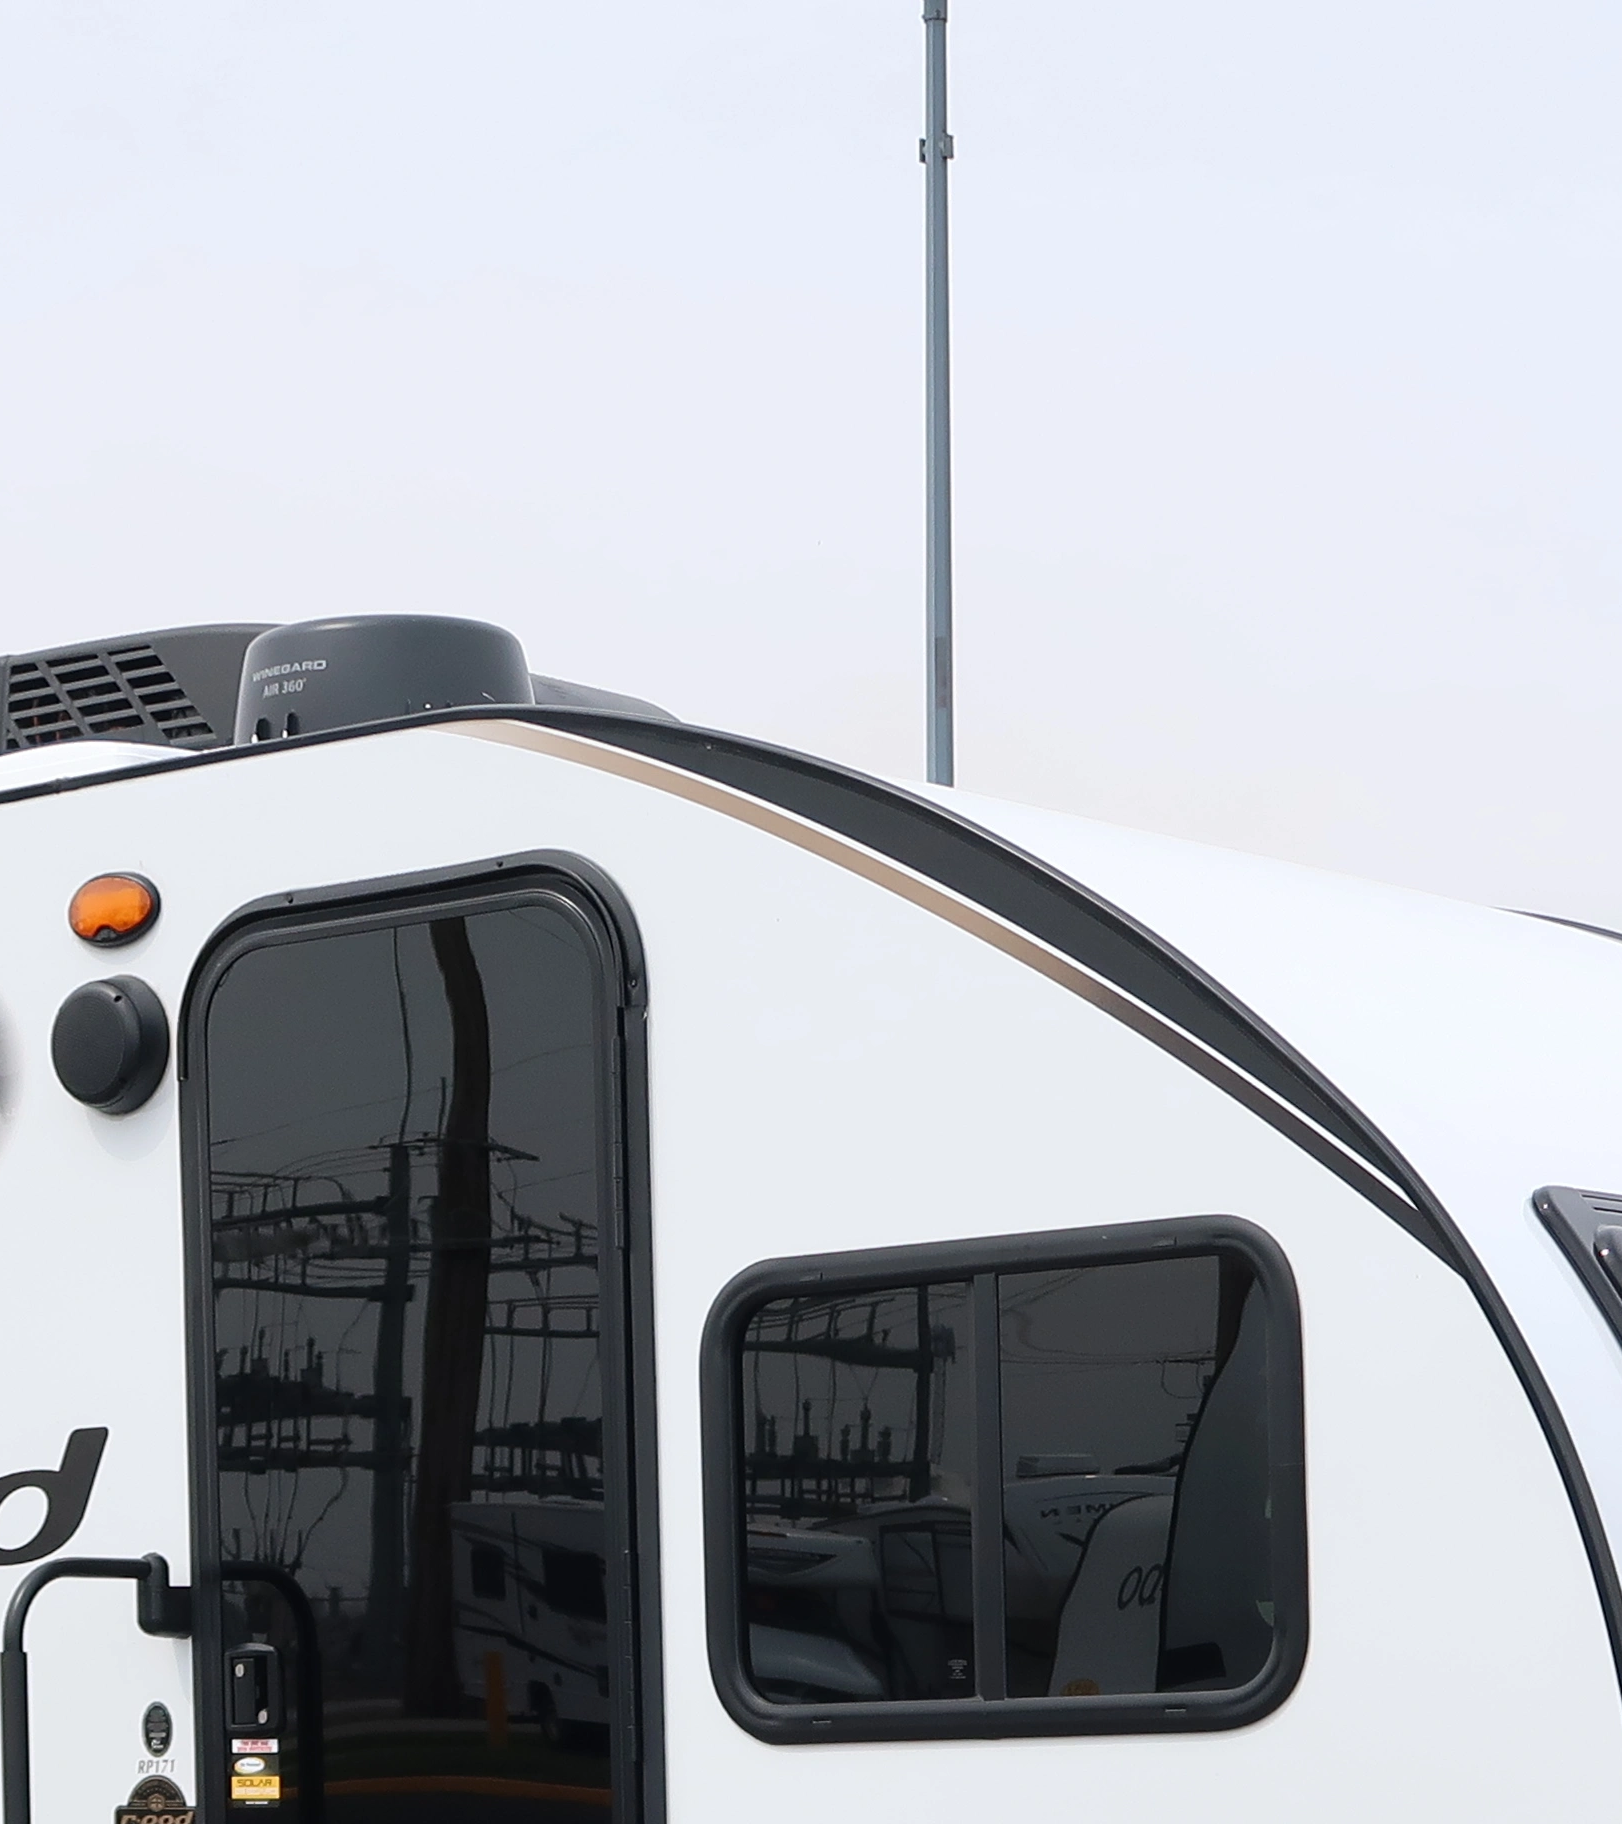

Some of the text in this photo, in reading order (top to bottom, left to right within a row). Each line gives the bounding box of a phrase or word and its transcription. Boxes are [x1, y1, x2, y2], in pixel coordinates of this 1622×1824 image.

[252, 659, 327, 682] WINEGARD
[263, 683, 279, 699] AIR
[138, 1759, 176, 1774] RP171
[236, 1779, 272, 1787] SOLAR
